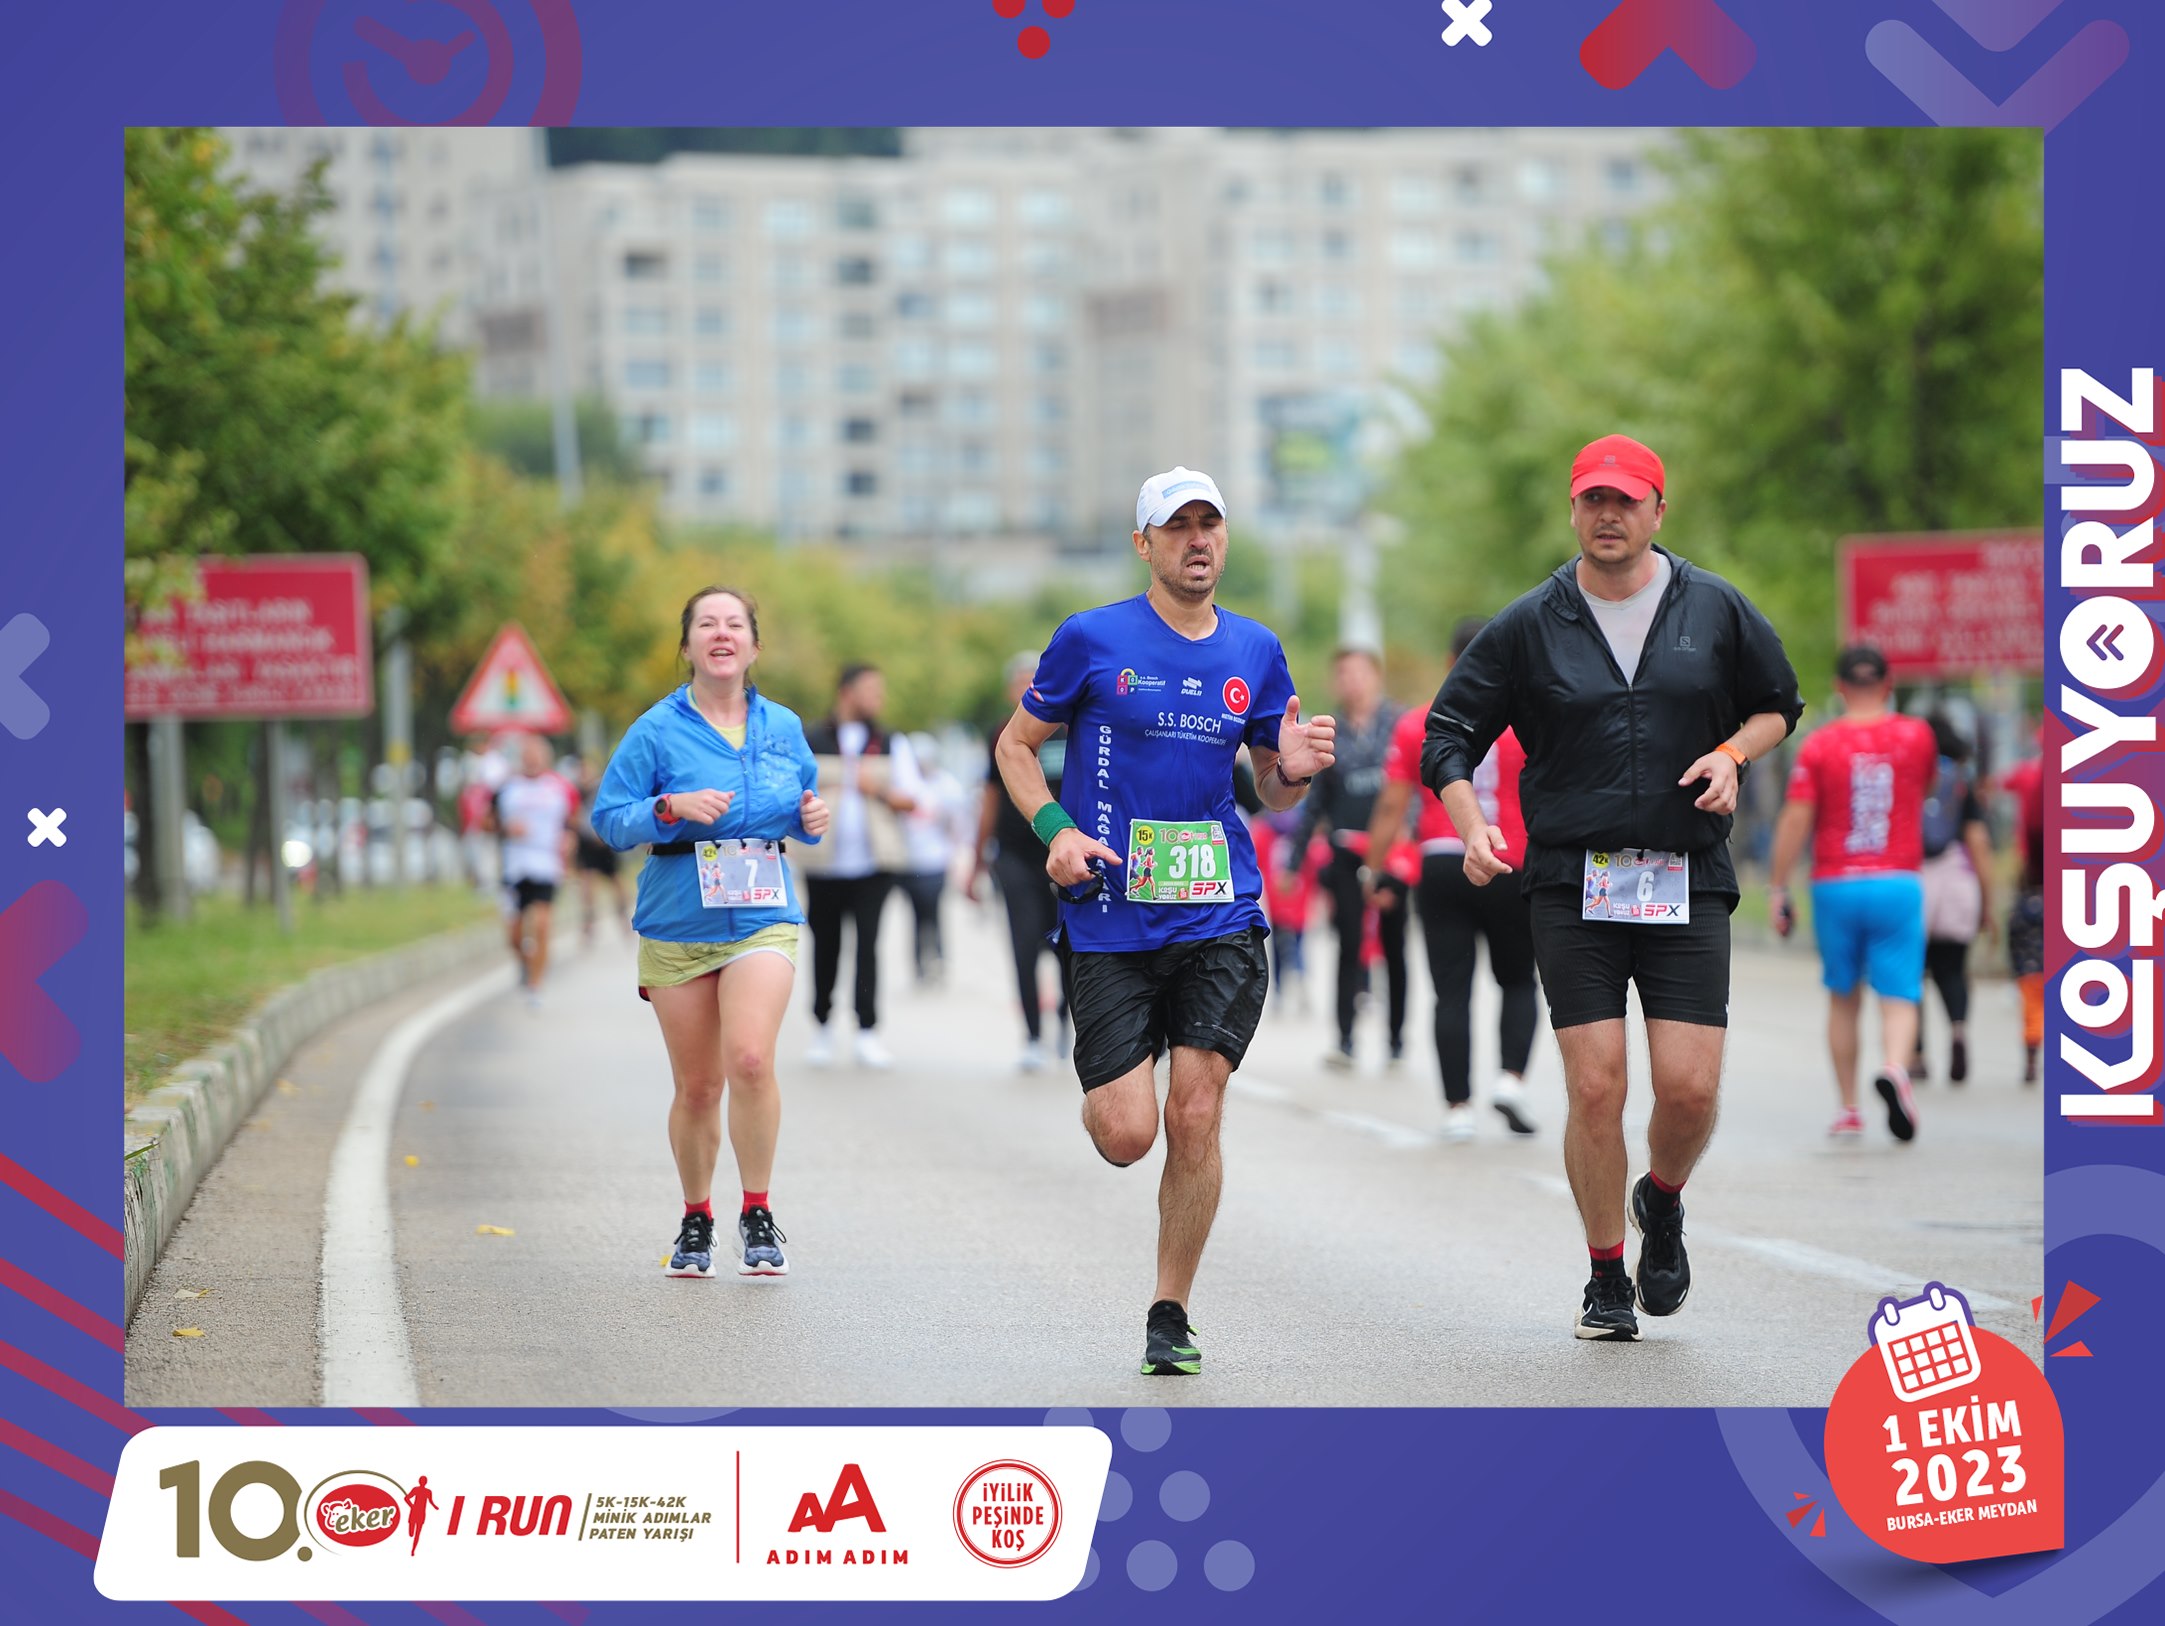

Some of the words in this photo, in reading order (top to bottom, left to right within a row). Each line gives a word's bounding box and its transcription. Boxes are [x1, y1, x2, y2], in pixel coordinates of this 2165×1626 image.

[1158, 712, 1176, 727] S.S.
[1180, 713, 1221, 734] BOSCH
[1097, 725, 1112, 789] GÜRDAL
[745, 859, 758, 888] 7
[1169, 844, 1216, 879] 318
[753, 889, 779, 900] SPX
[1192, 882, 1227, 896] SPX
[1637, 871, 1655, 902] 6
[1644, 904, 1681, 917] SPX
